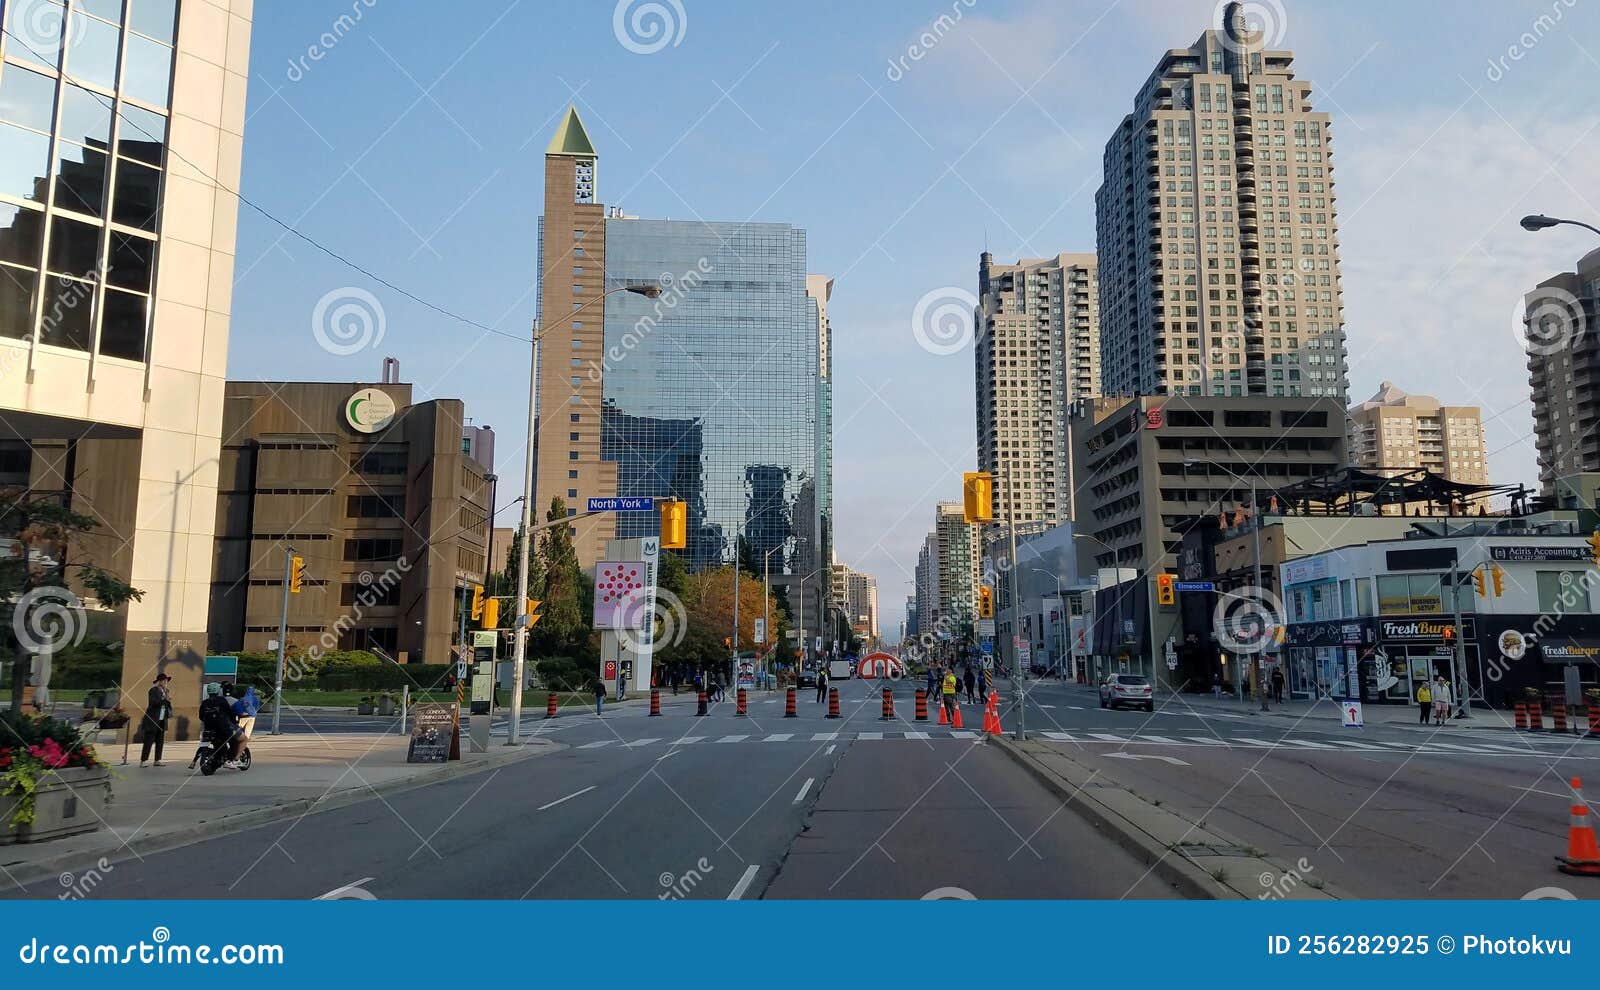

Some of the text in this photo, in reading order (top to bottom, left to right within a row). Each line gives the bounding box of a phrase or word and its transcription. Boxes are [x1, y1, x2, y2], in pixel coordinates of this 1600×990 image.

[590, 499, 617, 509] North
[621, 499, 641, 509] York
[1509, 547, 1532, 555] Aciris
[1534, 547, 1578, 558] Accounting
[1543, 646, 1600, 655] FreshBurger
